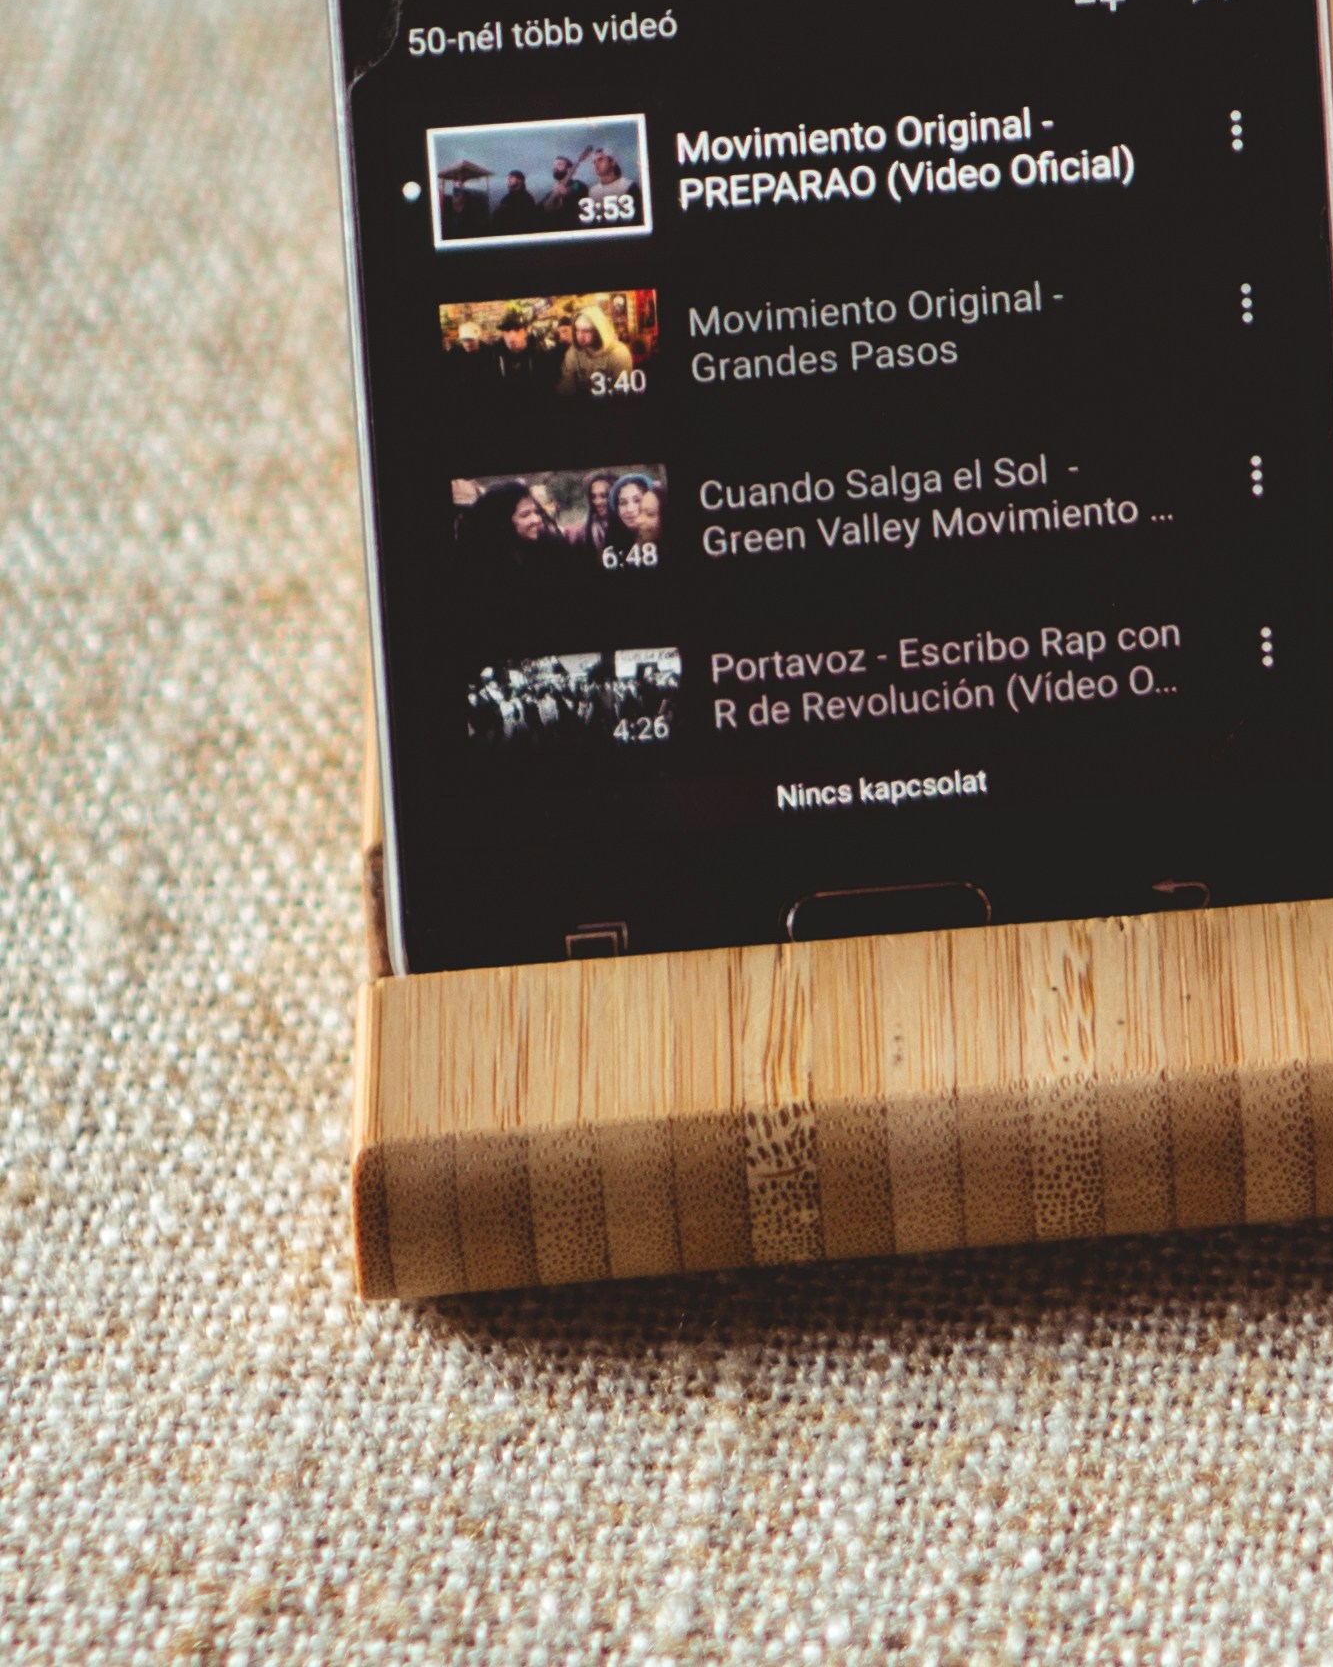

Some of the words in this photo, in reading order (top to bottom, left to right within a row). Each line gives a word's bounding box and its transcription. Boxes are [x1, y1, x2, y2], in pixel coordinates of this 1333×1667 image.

[408, 21, 503, 57] 50-nél
[510, 16, 584, 49] több
[592, 8, 678, 43] videó
[676, 121, 887, 165] Movimiento
[895, 106, 1032, 153] Original
[678, 165, 877, 211] PREPARAO
[887, 157, 1002, 203] (Video
[1010, 143, 1135, 187] Oficial)
[578, 194, 637, 224] 3:53
[688, 296, 897, 337] Movimiento
[908, 280, 1042, 324] Original
[589, 368, 649, 398] 3:40
[691, 344, 838, 383] Grandes
[851, 340, 958, 371] Pasos
[699, 471, 835, 511] Cuando
[845, 465, 943, 503] Salga
[953, 458, 982, 491] el
[994, 453, 1047, 488] Sol
[702, 525, 806, 557] Green
[816, 512, 920, 549] Valley
[932, 497, 1139, 539] Movimiento
[601, 542, 659, 571] 6:48
[711, 649, 866, 684] Portavoz
[899, 630, 1030, 669] Escribo
[1040, 627, 1107, 661] Rap
[1117, 624, 1181, 651] con
[714, 698, 737, 729] R
[748, 694, 791, 727] de
[802, 678, 995, 722] Revolución
[1006, 670, 1119, 713] (Vídeo
[612, 714, 671, 743] 4:26
[776, 783, 853, 810] Nincs
[858, 769, 988, 805] kapcsolat
